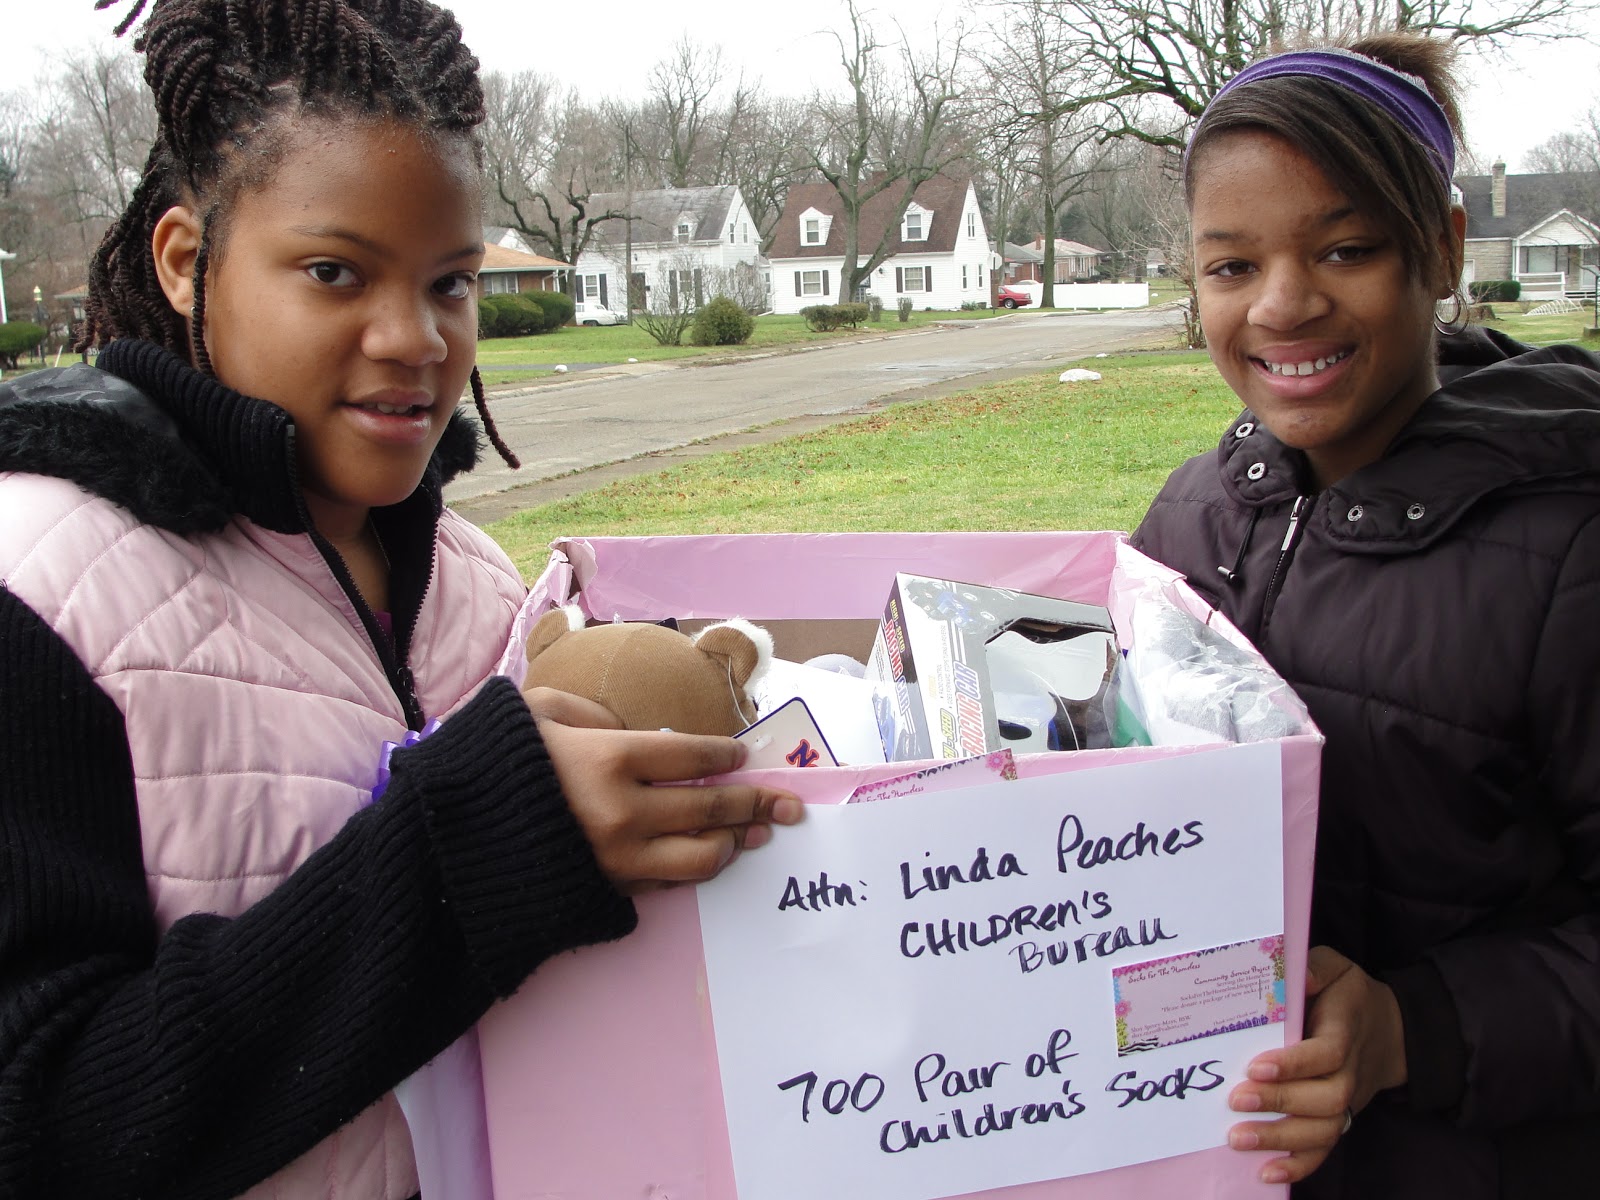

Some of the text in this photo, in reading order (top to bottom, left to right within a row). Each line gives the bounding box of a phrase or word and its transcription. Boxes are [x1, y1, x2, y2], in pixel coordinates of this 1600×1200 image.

[884, 618, 911, 716] RACING CAR
[953, 660, 987, 756] RACING CAR
[877, 791, 890, 801] The
[891, 784, 924, 798] Homeless
[900, 847, 1028, 899] Linda
[1057, 814, 1204, 873] Peaches
[1008, 918, 1178, 973] Bureau
[1128, 961, 1201, 984] Socks For The Homeless
[1194, 965, 1271, 985] Community Service Project
[777, 1029, 1079, 1123] 700 Pair of
[880, 1080, 1086, 1153] Children's
